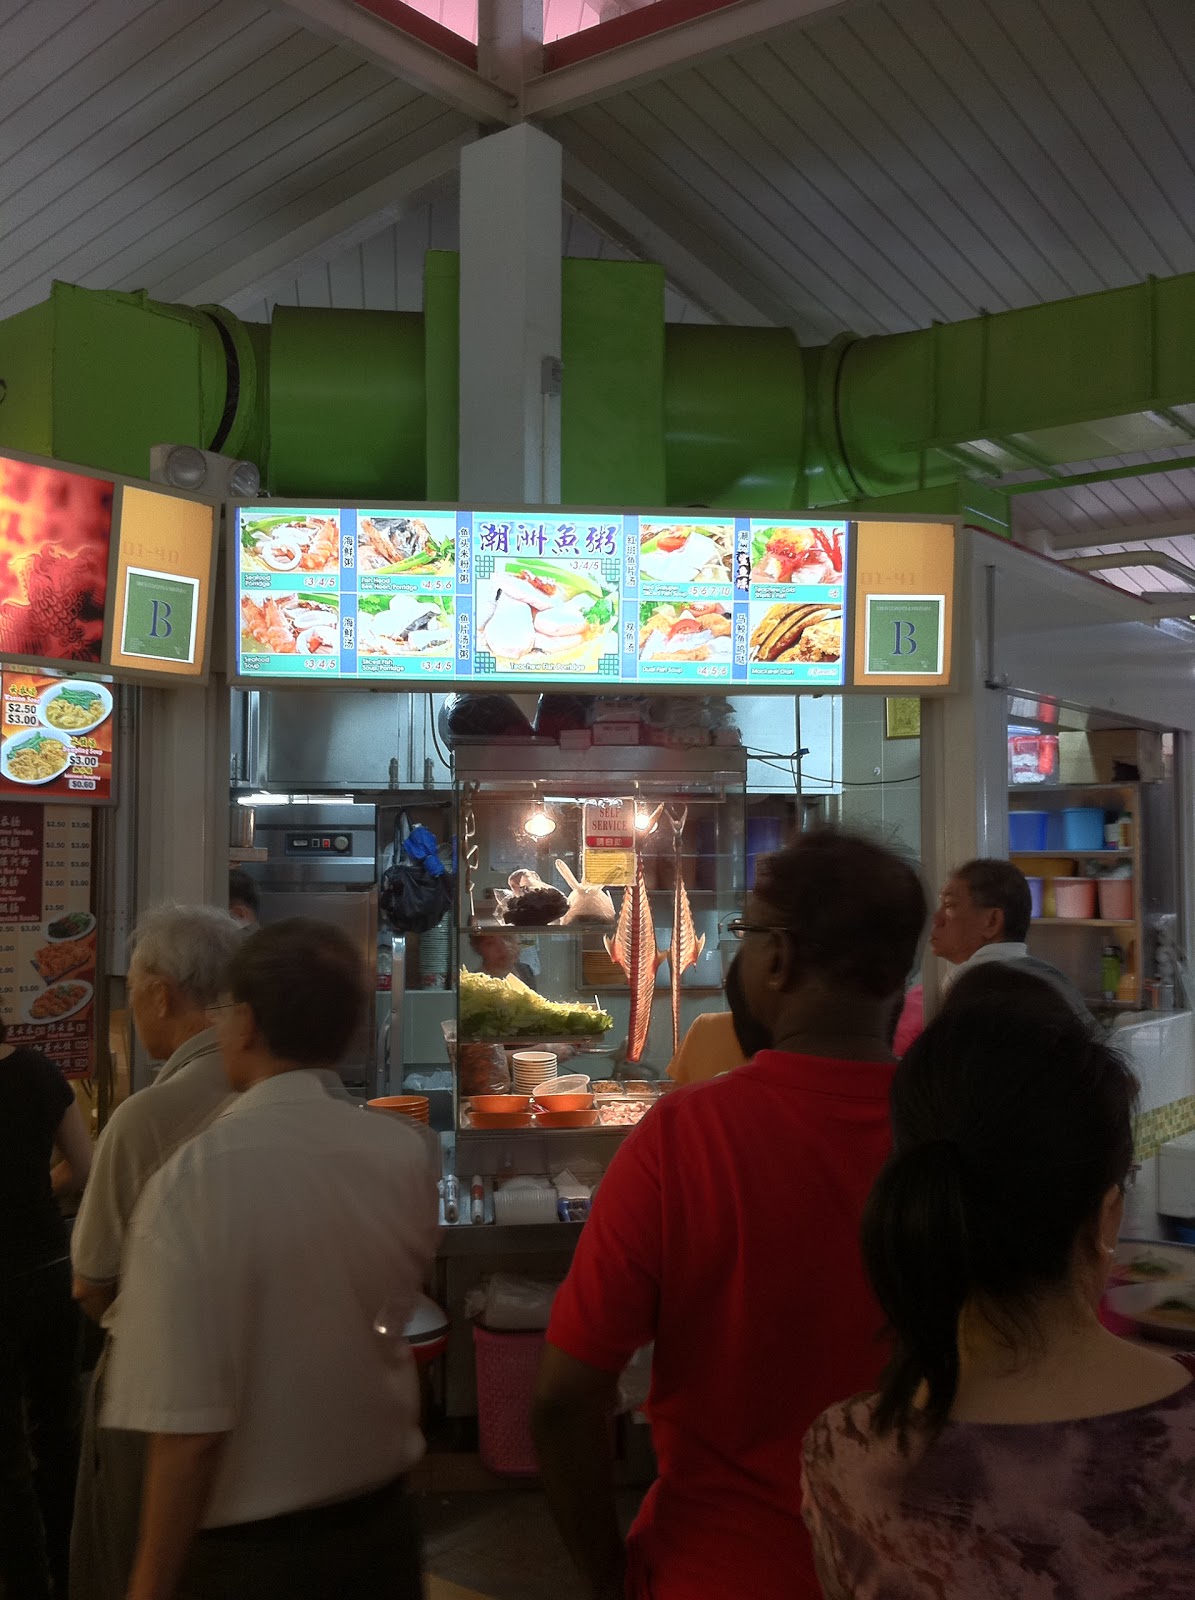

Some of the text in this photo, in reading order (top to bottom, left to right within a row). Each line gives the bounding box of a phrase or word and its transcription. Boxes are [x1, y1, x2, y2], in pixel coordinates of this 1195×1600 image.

[149, 599, 173, 639] B
[891, 619, 918, 656] B
[510, 662, 585, 672] Teochew Fish Porridge
[8, 703, 37, 714] $2.50
[8, 714, 37, 725] $3.00
[69, 756, 97, 766] $3.00
[72, 781, 94, 789] $0.60
[600, 807, 620, 818] SELF
[592, 820, 628, 831] SERVICE
